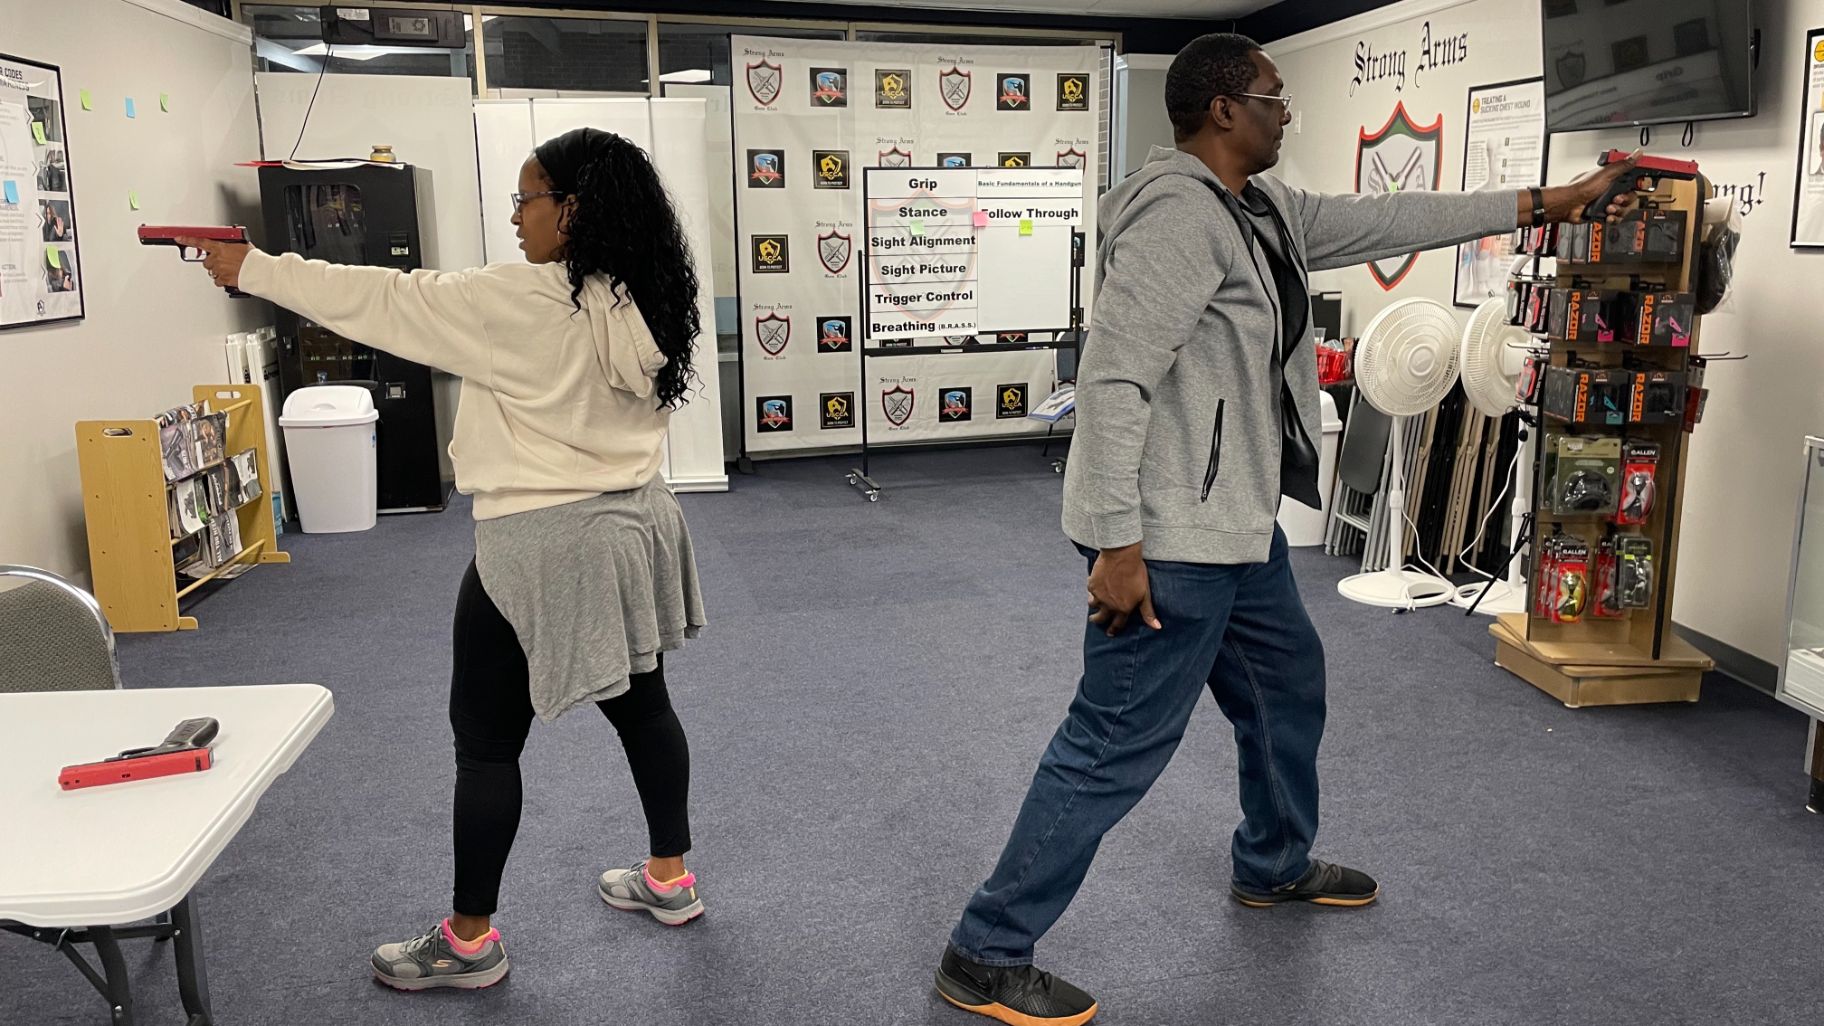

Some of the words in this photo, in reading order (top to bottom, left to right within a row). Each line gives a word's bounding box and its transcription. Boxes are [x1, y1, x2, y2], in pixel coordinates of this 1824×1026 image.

[1350, 40, 1406, 98] Strong
[1414, 21, 1468, 89] Arms
[4, 67, 24, 80] CODES
[1481, 95, 1503, 105] TREATING
[909, 178, 938, 191] Grip
[899, 206, 948, 217] Stance
[1026, 208, 1079, 220] Through
[871, 236, 906, 249] Sight
[909, 235, 976, 249] Alignment
[1591, 222, 1603, 262] AZOR
[881, 264, 915, 277] Sight
[919, 264, 967, 274] Picture
[875, 294, 922, 306] Trigger
[926, 290, 973, 302] Control
[1568, 291, 1581, 341] RAZOR
[1640, 294, 1655, 345] RAZOR
[872, 321, 936, 333] Breathing
[938, 322, 977, 330] (B.R.A.S.S.)
[1576, 372, 1590, 423] RAZOR
[1632, 372, 1646, 423] RAZOR
